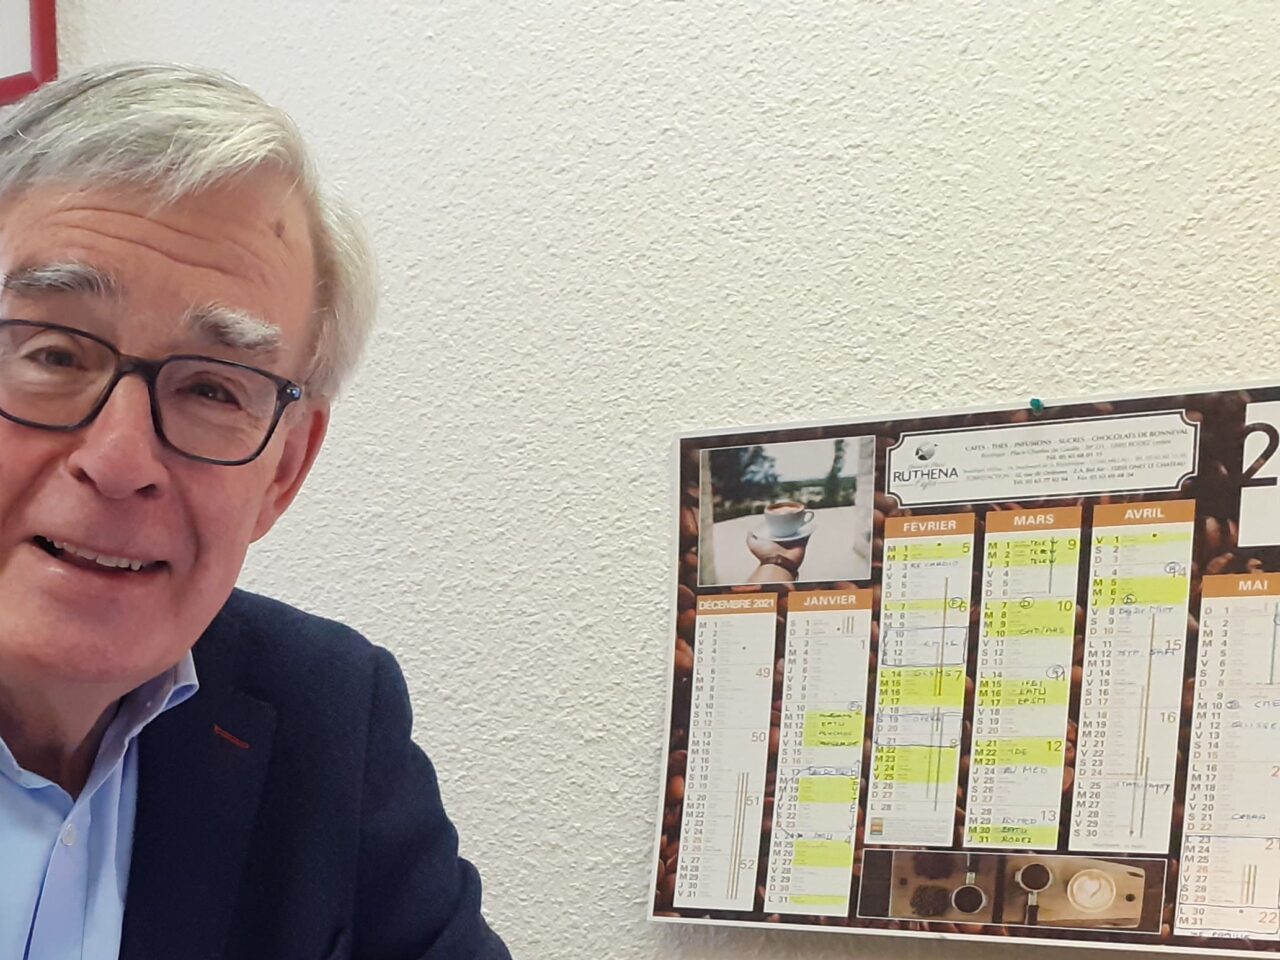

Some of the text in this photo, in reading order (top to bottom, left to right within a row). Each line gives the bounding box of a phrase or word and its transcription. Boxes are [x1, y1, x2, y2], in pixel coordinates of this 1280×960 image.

[893, 467, 959, 483] RUTHENA
[1124, 508, 1165, 519] AVRIL
[1014, 514, 1055, 526] MARS
[962, 544, 969, 553] 5
[1068, 539, 1076, 550] 9
[1239, 580, 1268, 591] MAI
[804, 595, 856, 606] JANVIER
[1058, 600, 1072, 612] 10
[959, 601, 967, 612] 6
[1165, 639, 1181, 650] 15
[756, 668, 770, 678] 49
[955, 670, 962, 680] 7
[1160, 712, 1176, 723] 16
[752, 732, 766, 742] 50
[1046, 741, 1062, 752] 12
[1041, 810, 1056, 821] 13
[740, 860, 754, 869] 52
[1259, 912, 1277, 923] 22
